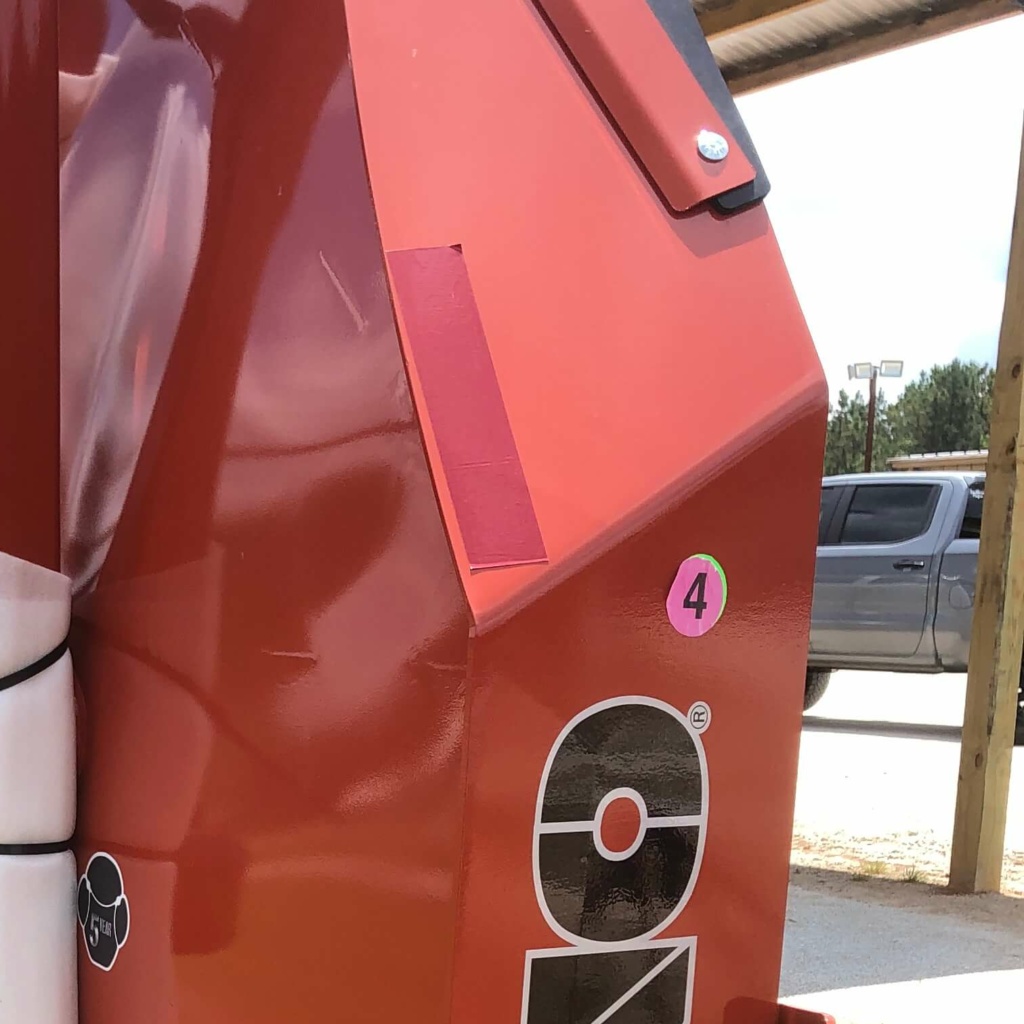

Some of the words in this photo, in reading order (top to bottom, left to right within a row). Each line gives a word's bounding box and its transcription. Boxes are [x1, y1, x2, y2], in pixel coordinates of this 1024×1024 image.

[682, 572, 708, 620] 4
[89, 912, 100, 947] 5
[99, 916, 112, 938] YEAR
